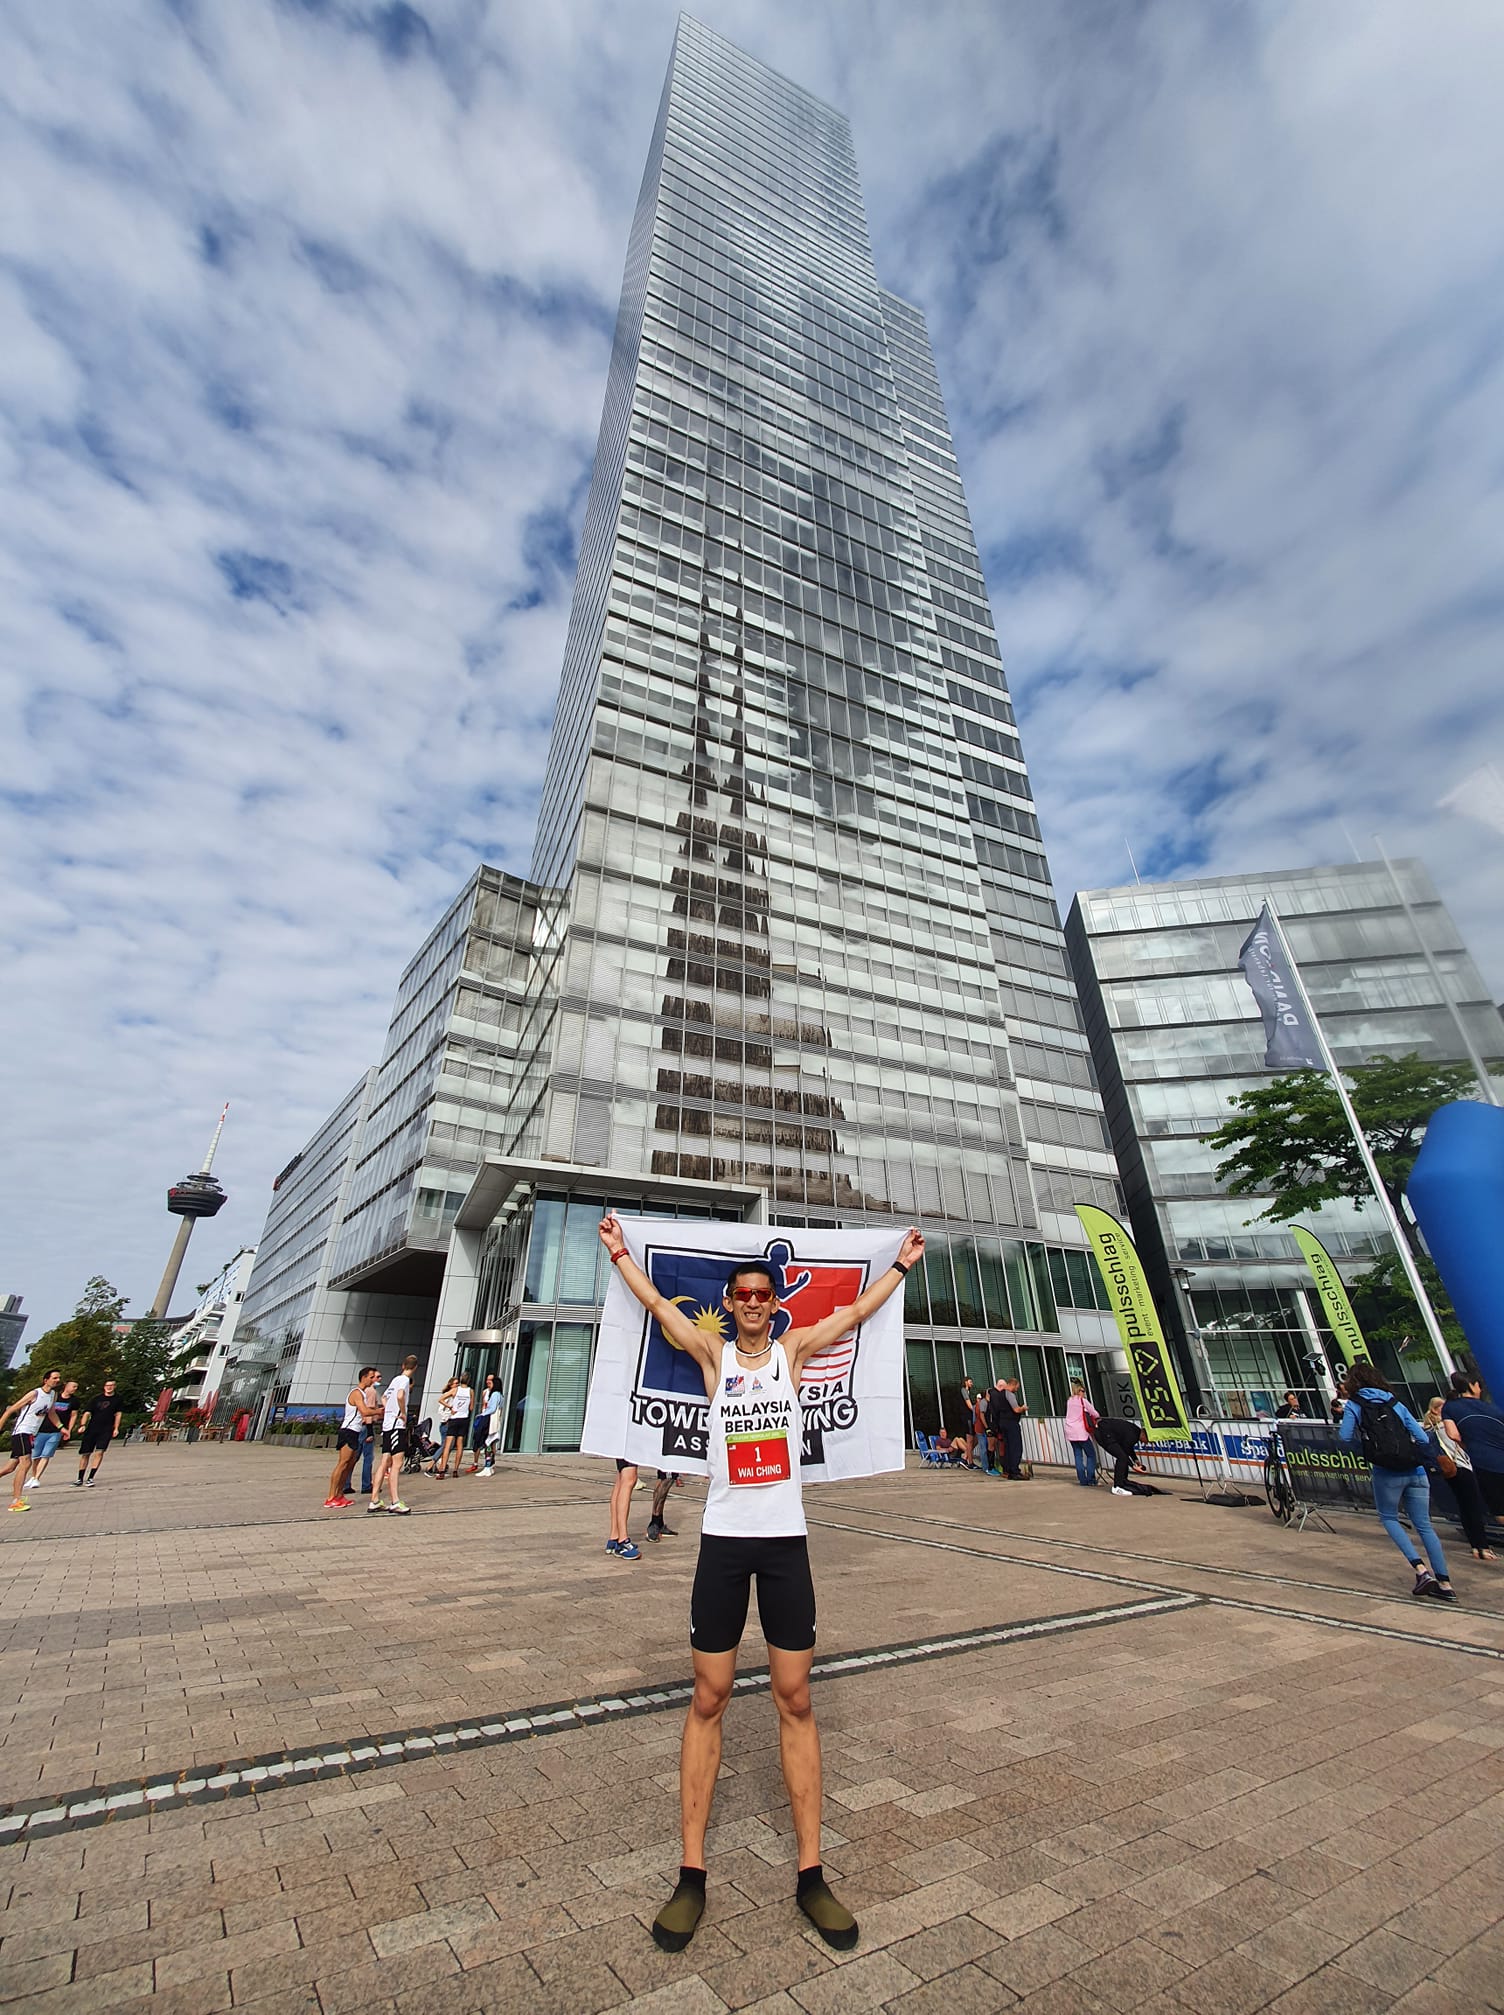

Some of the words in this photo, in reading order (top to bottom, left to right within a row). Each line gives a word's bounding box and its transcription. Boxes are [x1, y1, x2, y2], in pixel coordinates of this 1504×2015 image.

[1098, 1232, 1147, 1338] pulsschlag
[1129, 1265, 1145, 1307] marketing
[1142, 1313, 1153, 1336] event
[720, 1400, 792, 1418] MALAYSIA
[725, 1416, 790, 1433] BERJAYA
[754, 1446, 762, 1462] 1
[1286, 1447, 1374, 1470] pulsschla
[737, 1467, 754, 1478] WAI
[756, 1464, 782, 1477] CHING
